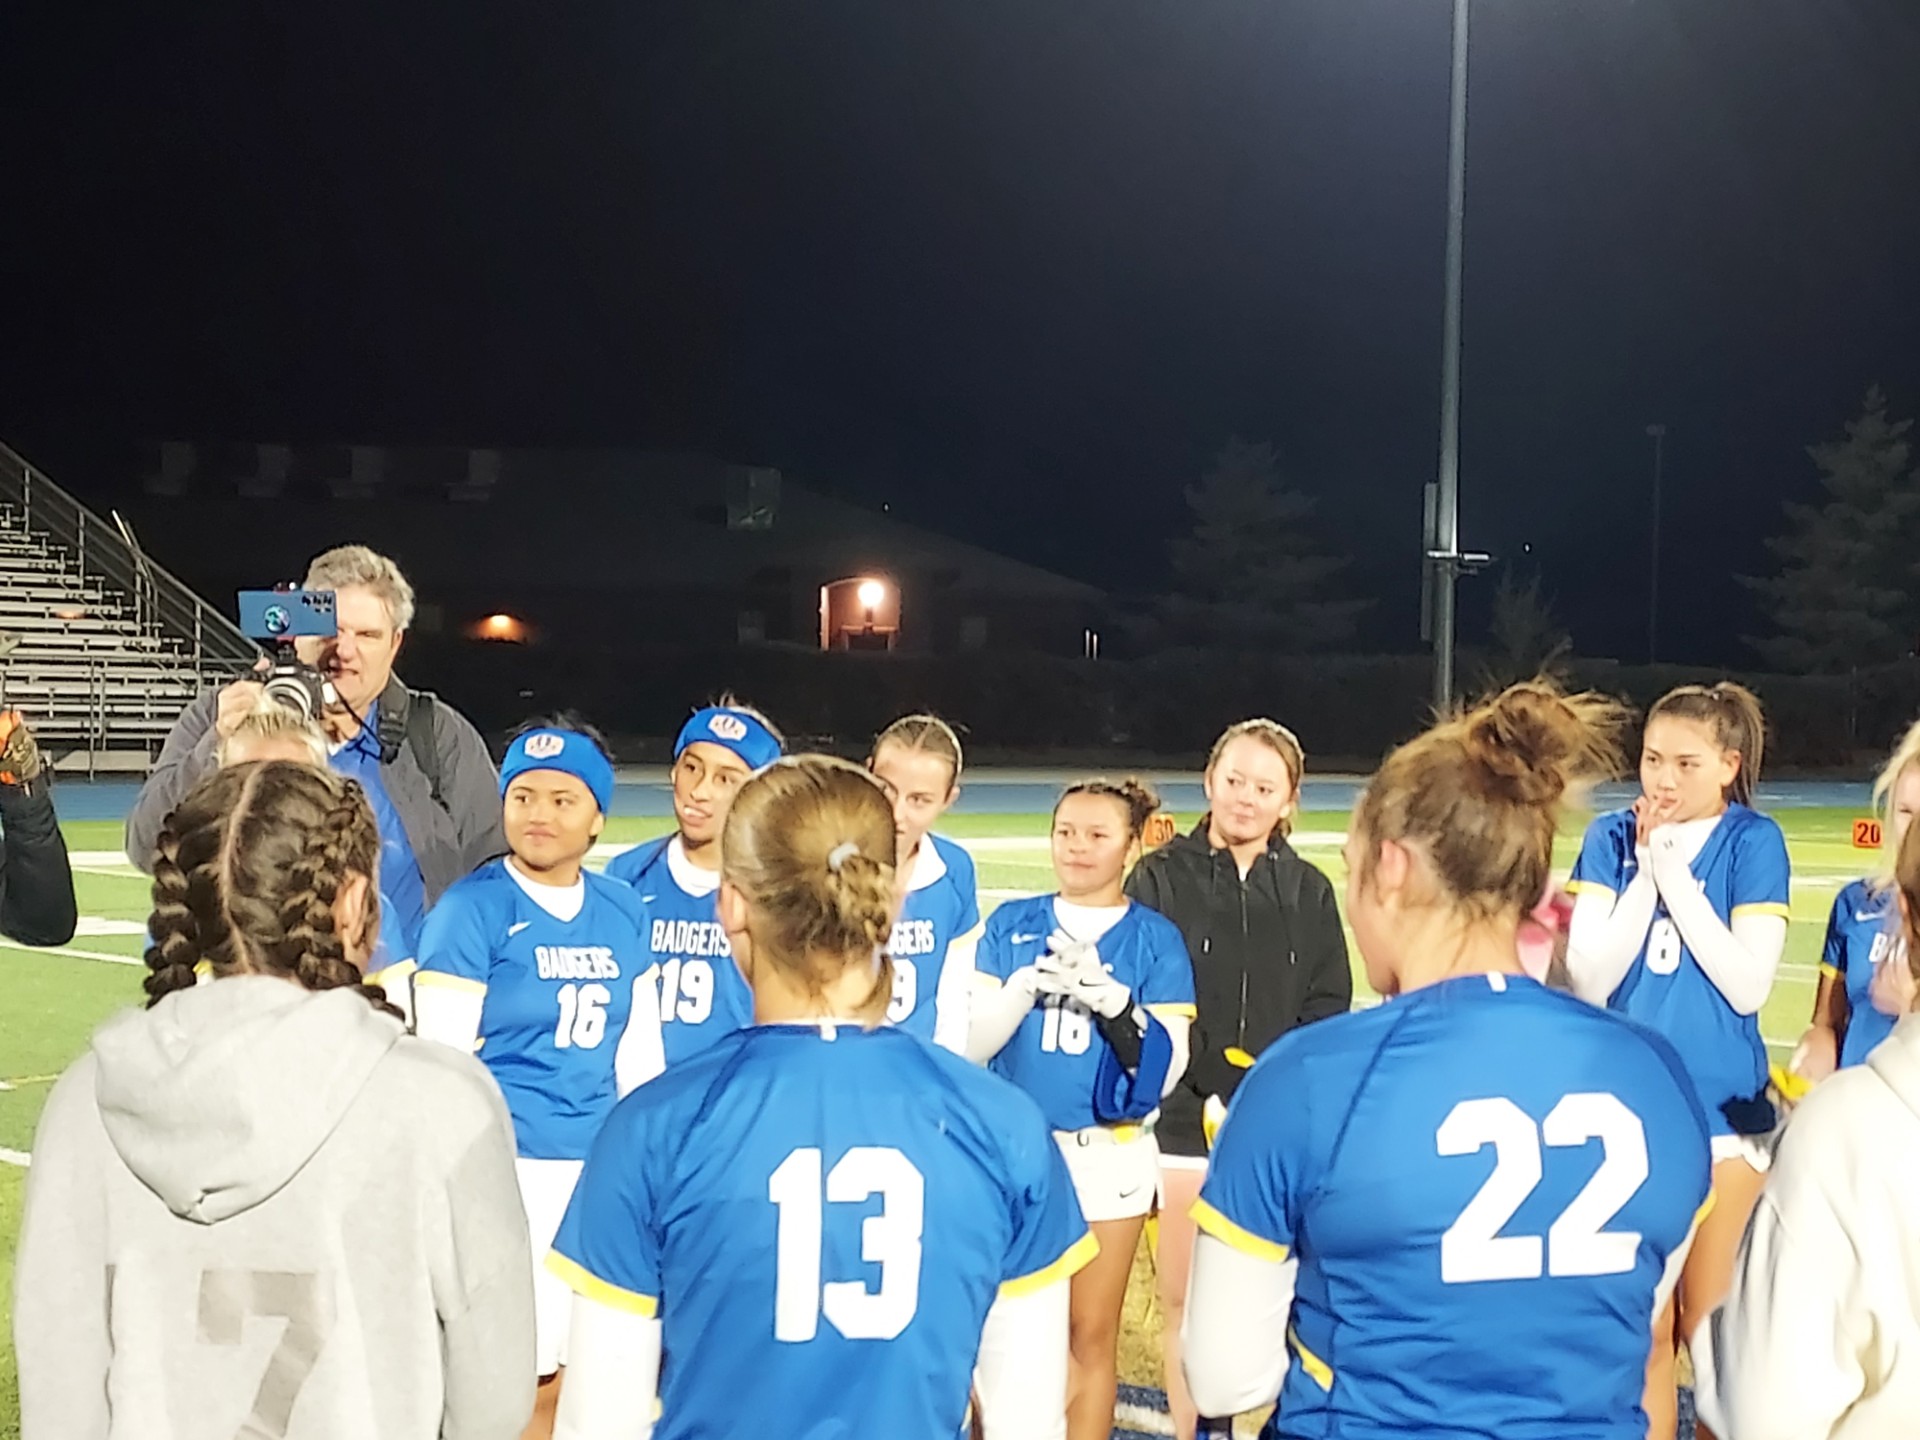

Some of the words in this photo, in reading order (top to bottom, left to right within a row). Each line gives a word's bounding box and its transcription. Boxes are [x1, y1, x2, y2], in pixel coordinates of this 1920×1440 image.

[1857, 822, 1881, 844] 20
[534, 946, 621, 980] BADGERS
[651, 919, 731, 957] BADGERS
[889, 919, 936, 955] GERS
[554, 983, 611, 1049] 16
[660, 958, 715, 1025] 19
[1436, 1091, 1650, 1283] 22
[768, 1146, 925, 1342] 13
[195, 1268, 338, 1440] 7
